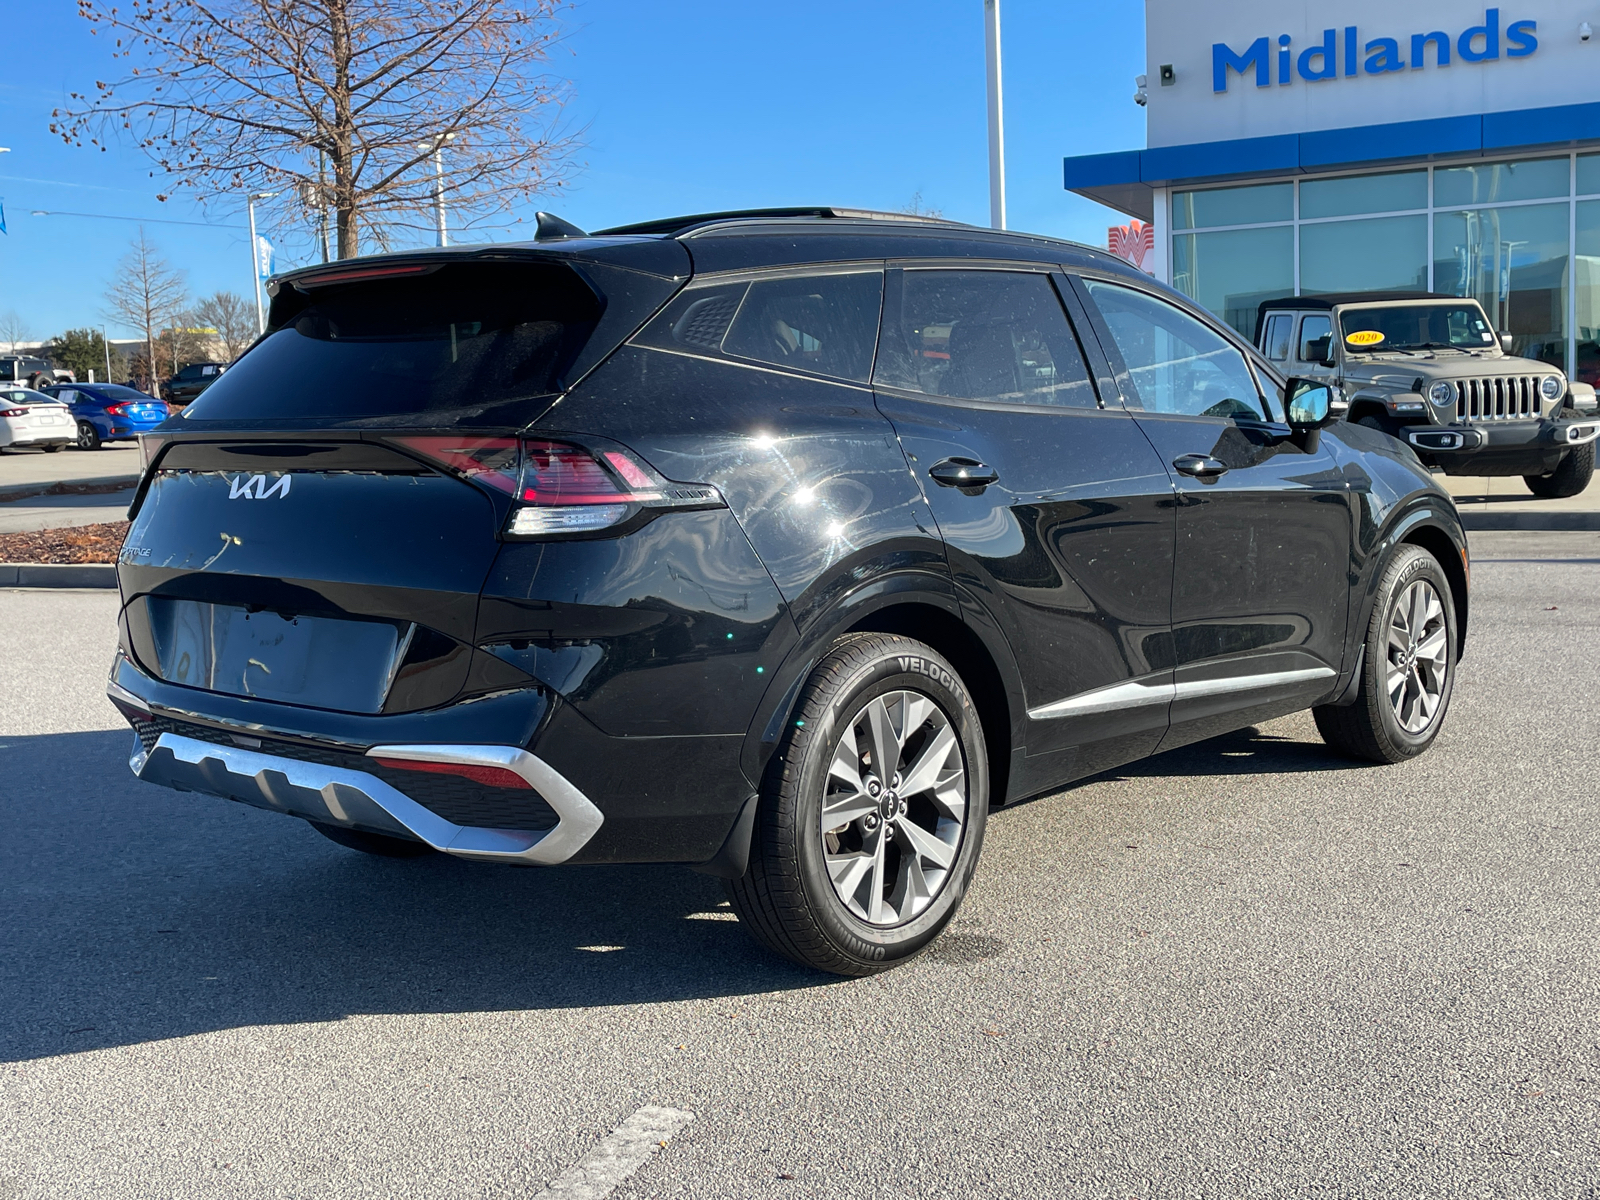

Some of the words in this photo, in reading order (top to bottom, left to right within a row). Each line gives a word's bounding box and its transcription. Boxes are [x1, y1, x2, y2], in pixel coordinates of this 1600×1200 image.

[1212, 8, 1538, 93] Midlands
[1353, 333, 1377, 342] 2020
[228, 474, 292, 500] KIA
[1400, 558, 1434, 583] VELOCIT
